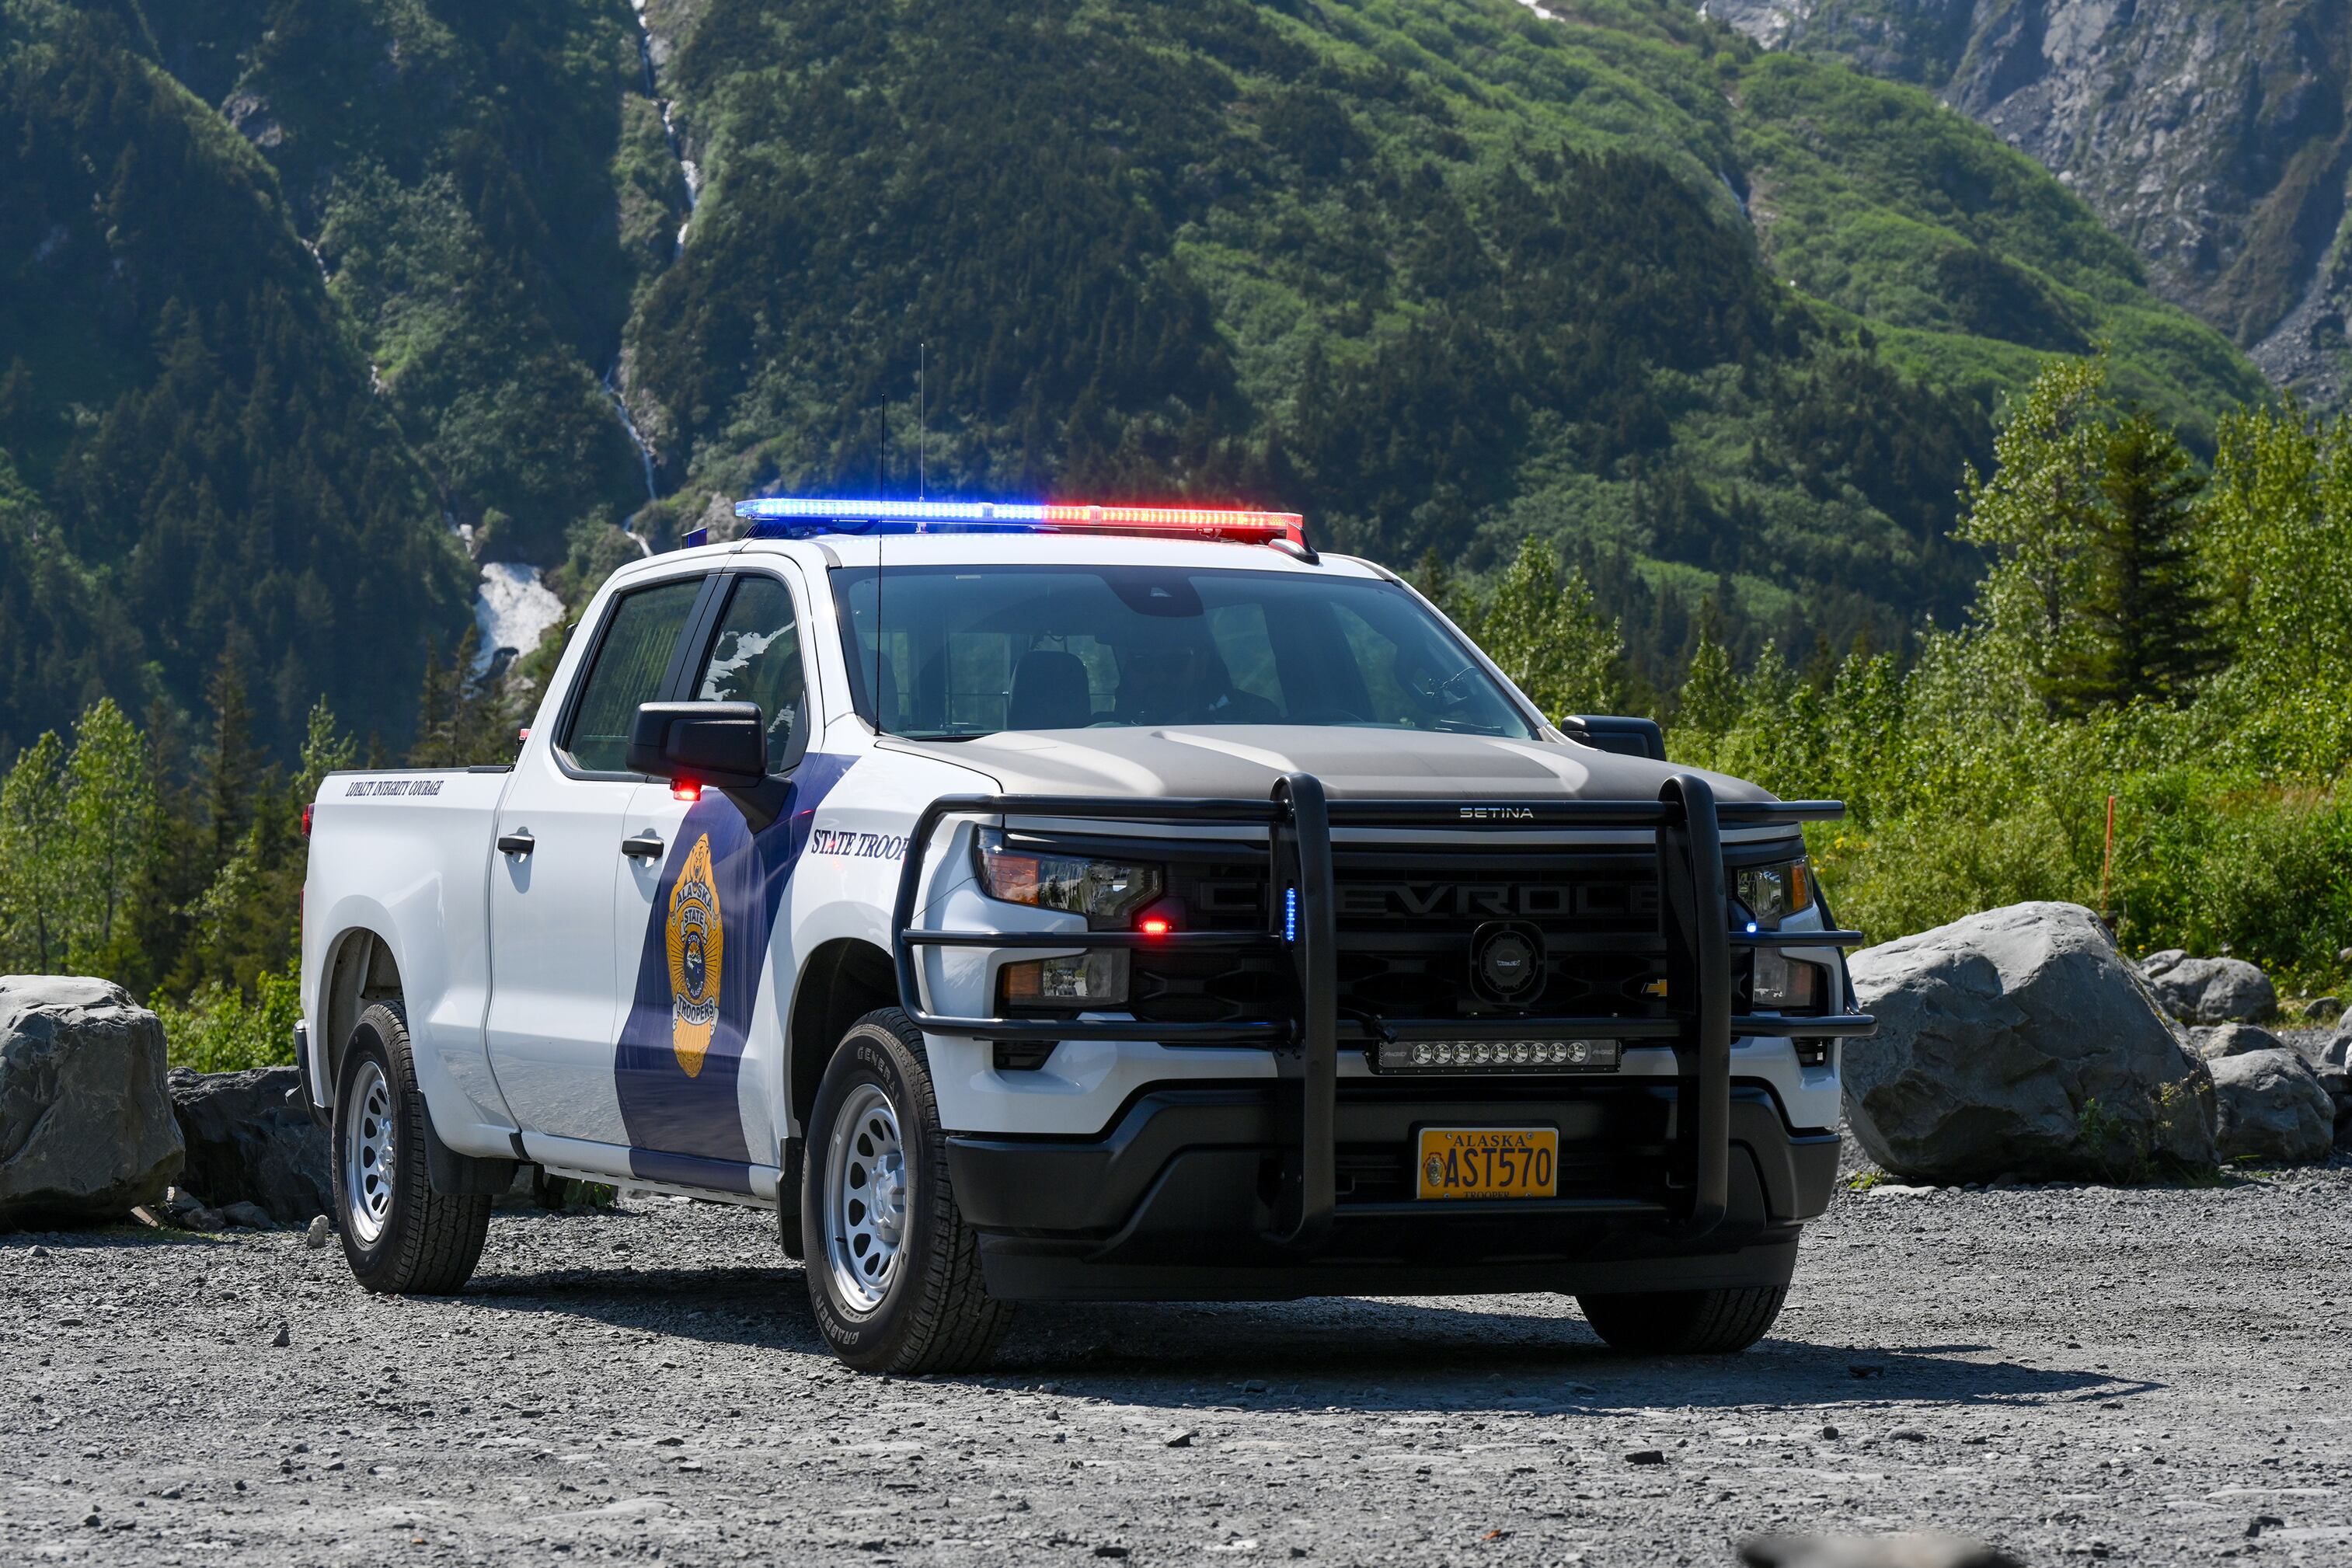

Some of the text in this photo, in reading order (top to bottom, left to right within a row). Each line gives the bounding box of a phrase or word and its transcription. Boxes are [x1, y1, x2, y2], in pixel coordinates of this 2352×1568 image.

[345, 780, 444, 796] LOYALTY INTEGRITY COURAGE
[1460, 807, 1534, 818] SETINA
[811, 829, 932, 862] STATE TROOP
[677, 884, 713, 911] ALASKA
[685, 909, 705, 925] STATE
[678, 995, 714, 1022] TROOPERS
[857, 1046, 901, 1109] GENERAL
[1453, 1134, 1526, 1147] ALASKA
[1444, 1148, 1552, 1188] AST570
[815, 1294, 860, 1345] GRABBER
